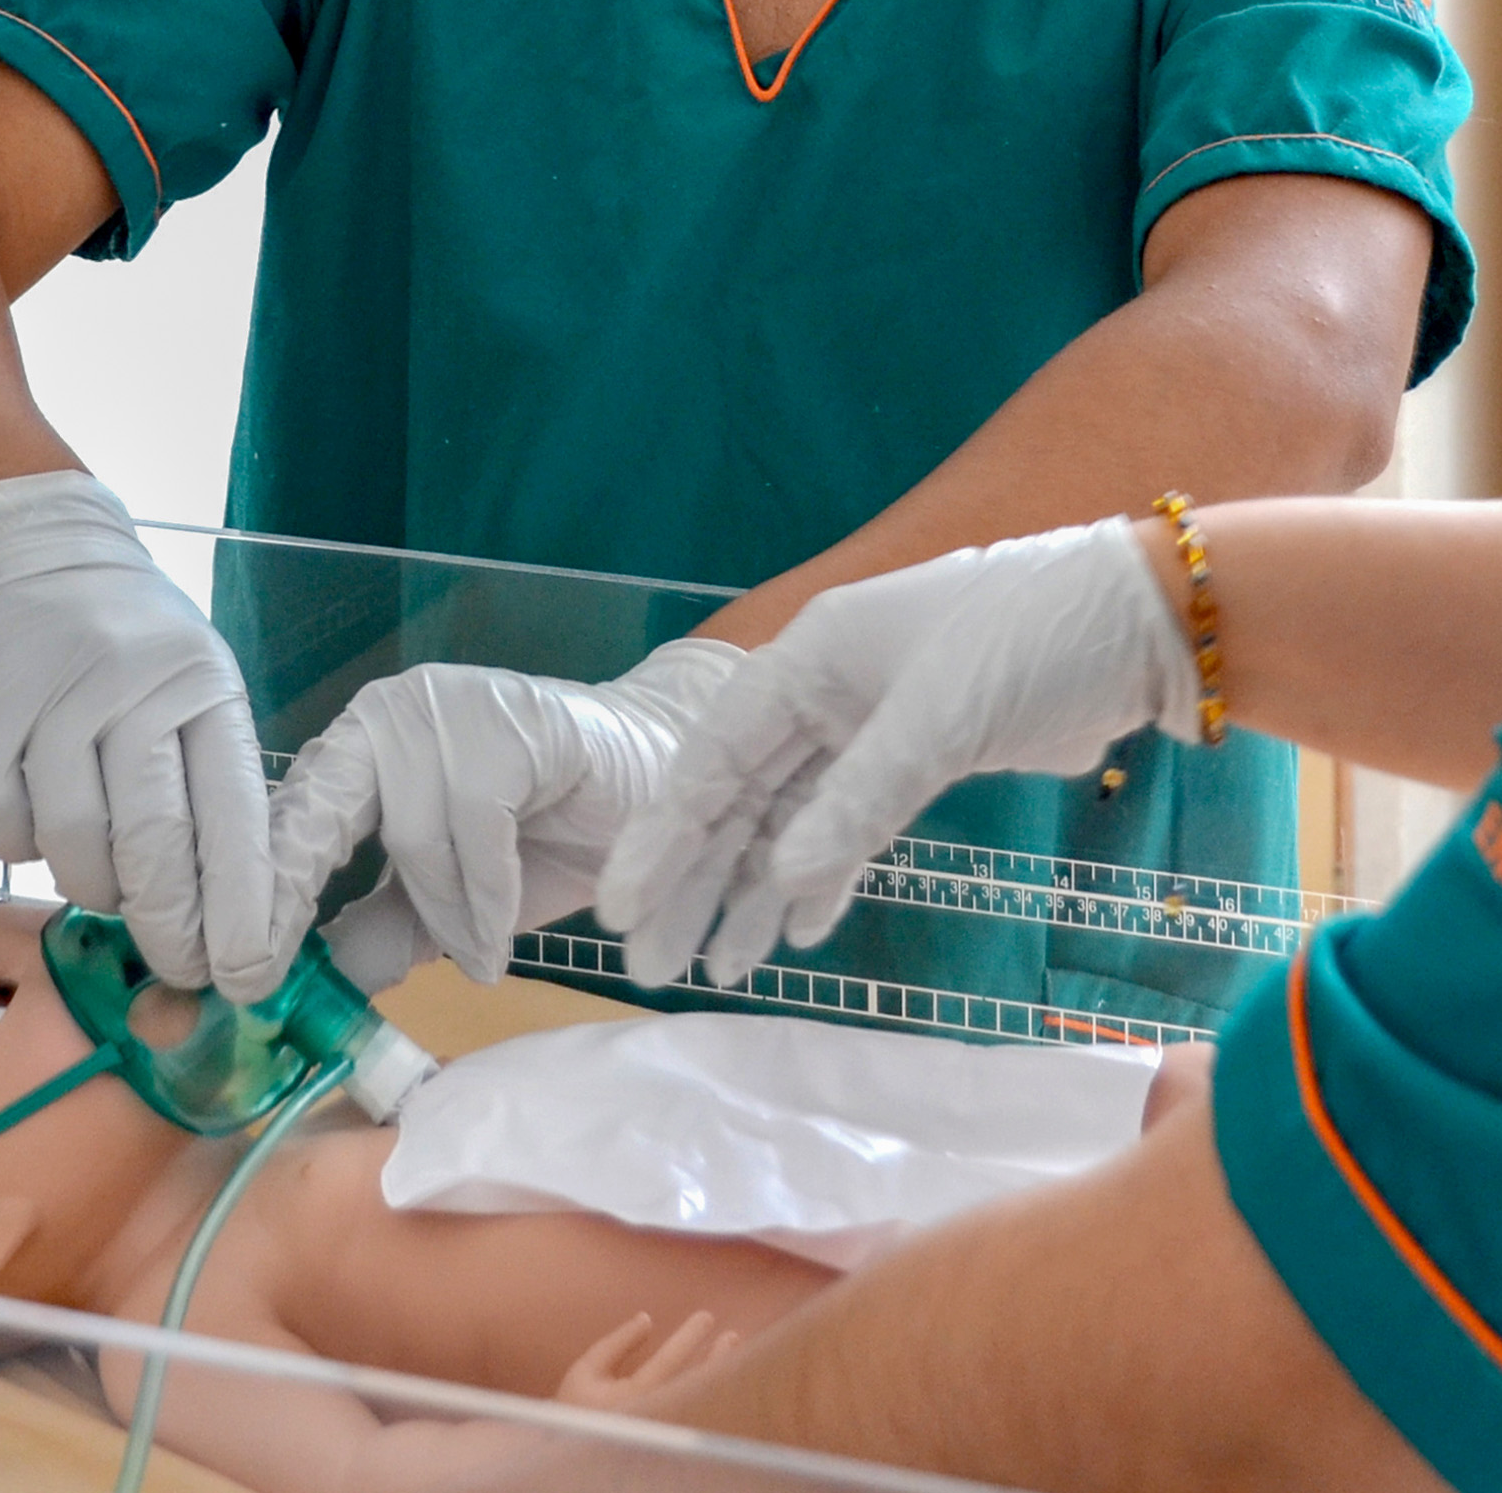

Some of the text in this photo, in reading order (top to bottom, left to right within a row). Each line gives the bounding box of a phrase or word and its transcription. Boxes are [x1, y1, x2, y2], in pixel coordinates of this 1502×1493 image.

[892, 853, 1319, 923] 12 13 14 15 16 17
